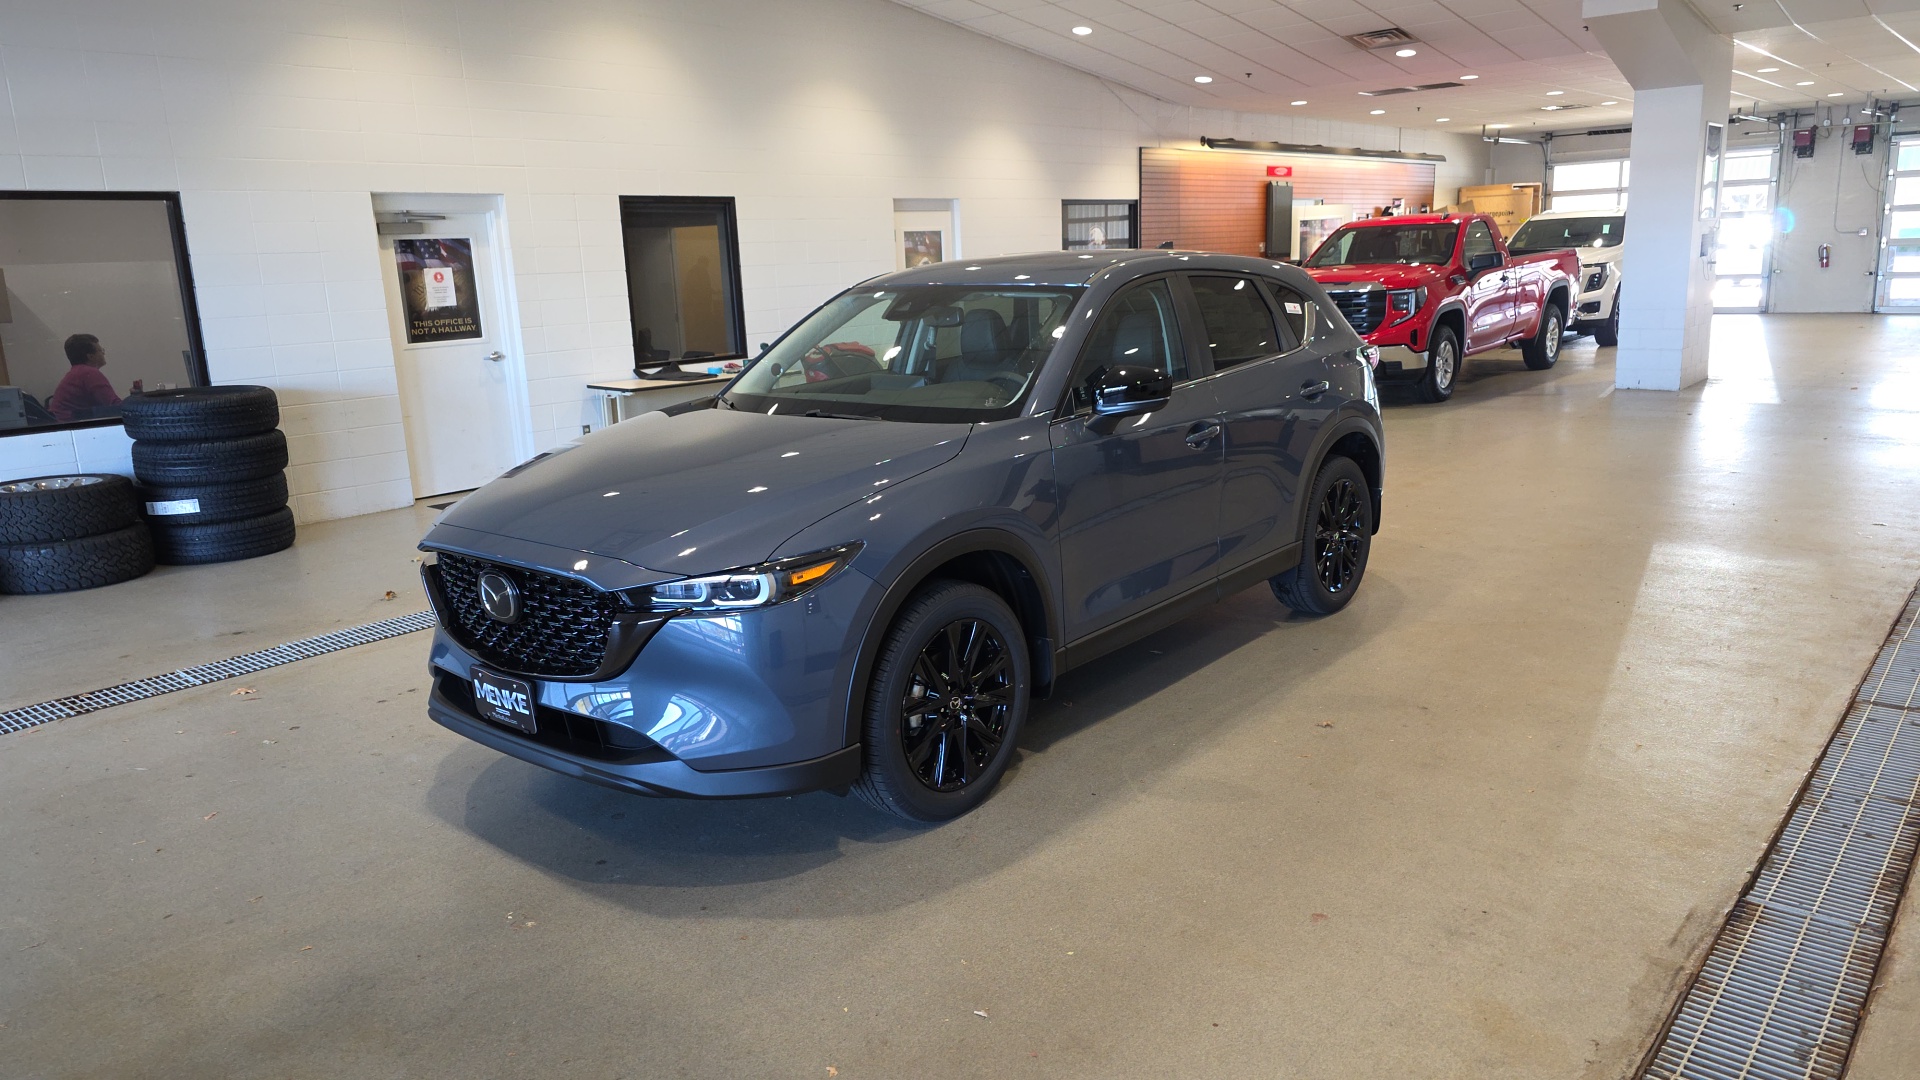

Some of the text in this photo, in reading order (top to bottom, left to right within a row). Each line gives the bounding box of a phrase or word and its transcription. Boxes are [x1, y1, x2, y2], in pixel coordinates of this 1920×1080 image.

[413, 320, 433, 328] THIS
[434, 317, 464, 326] OFFICE
[411, 328, 430, 336] NOT
[438, 324, 477, 334] HALLWAY
[473, 678, 530, 716] MENKE
